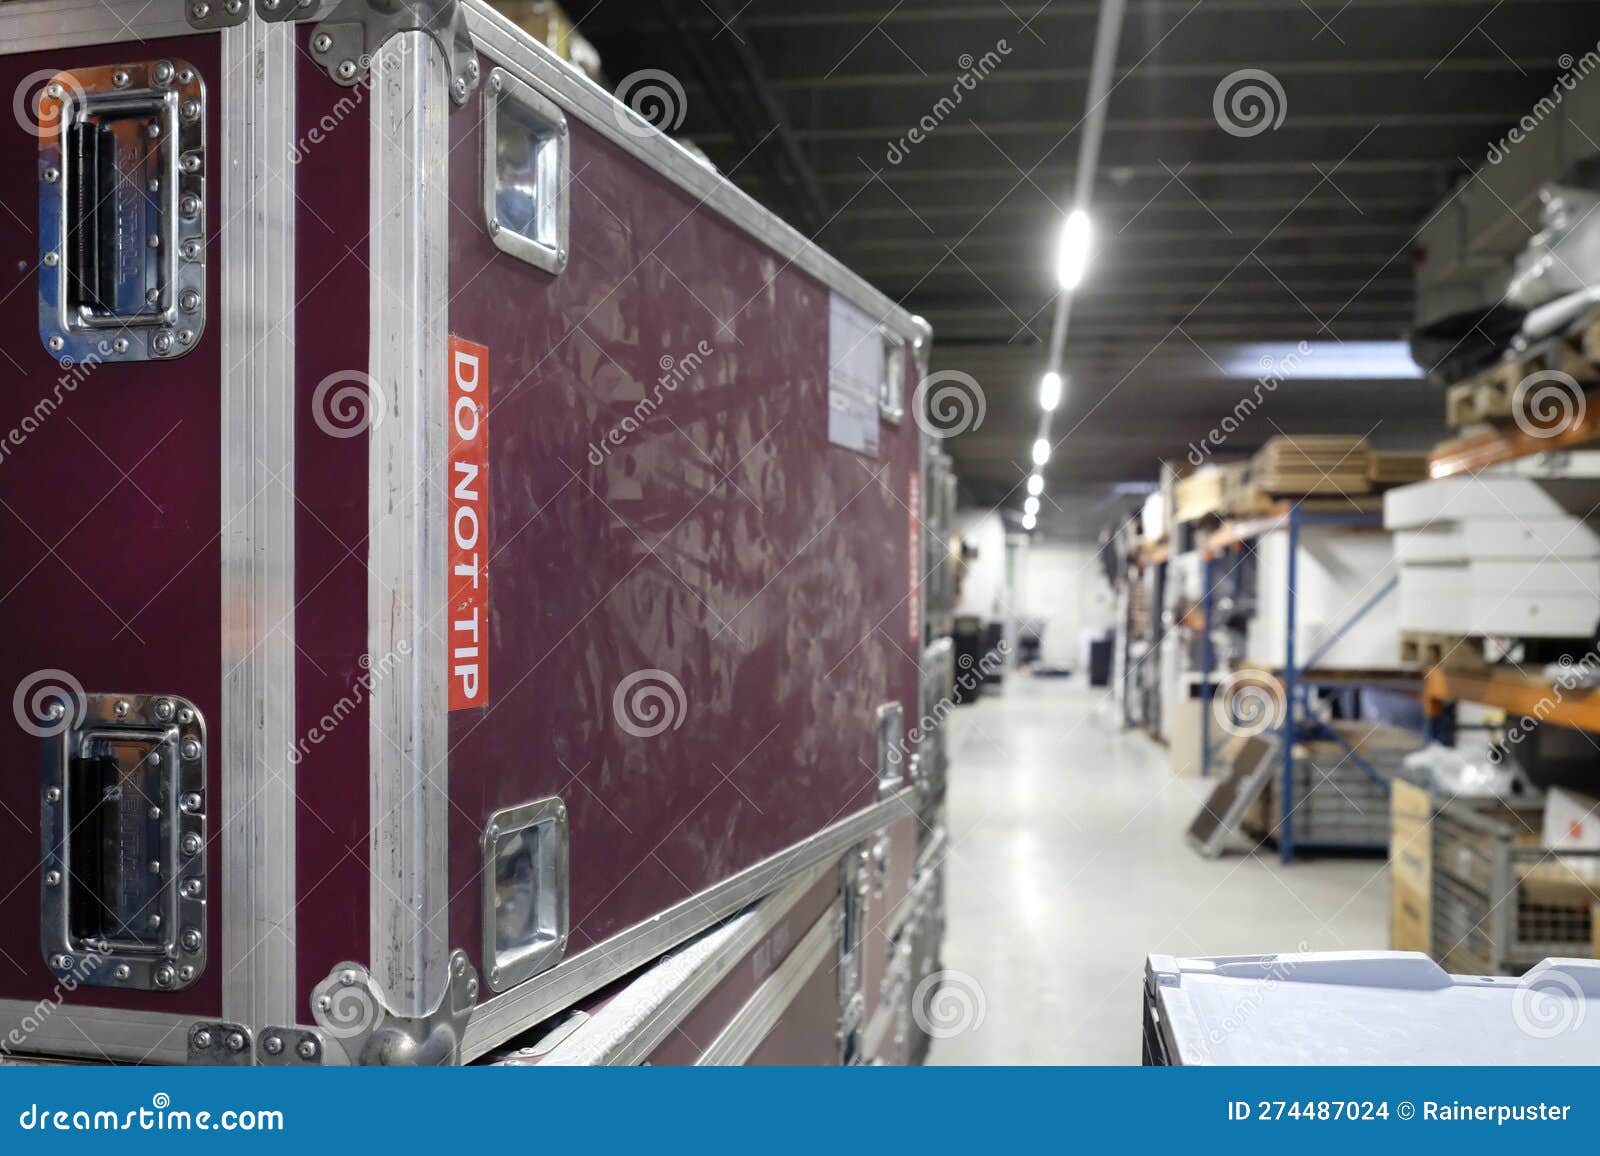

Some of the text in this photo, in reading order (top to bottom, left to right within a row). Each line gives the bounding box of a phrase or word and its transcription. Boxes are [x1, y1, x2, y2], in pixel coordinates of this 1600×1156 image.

[454, 351, 479, 699] DO NOT TIP
